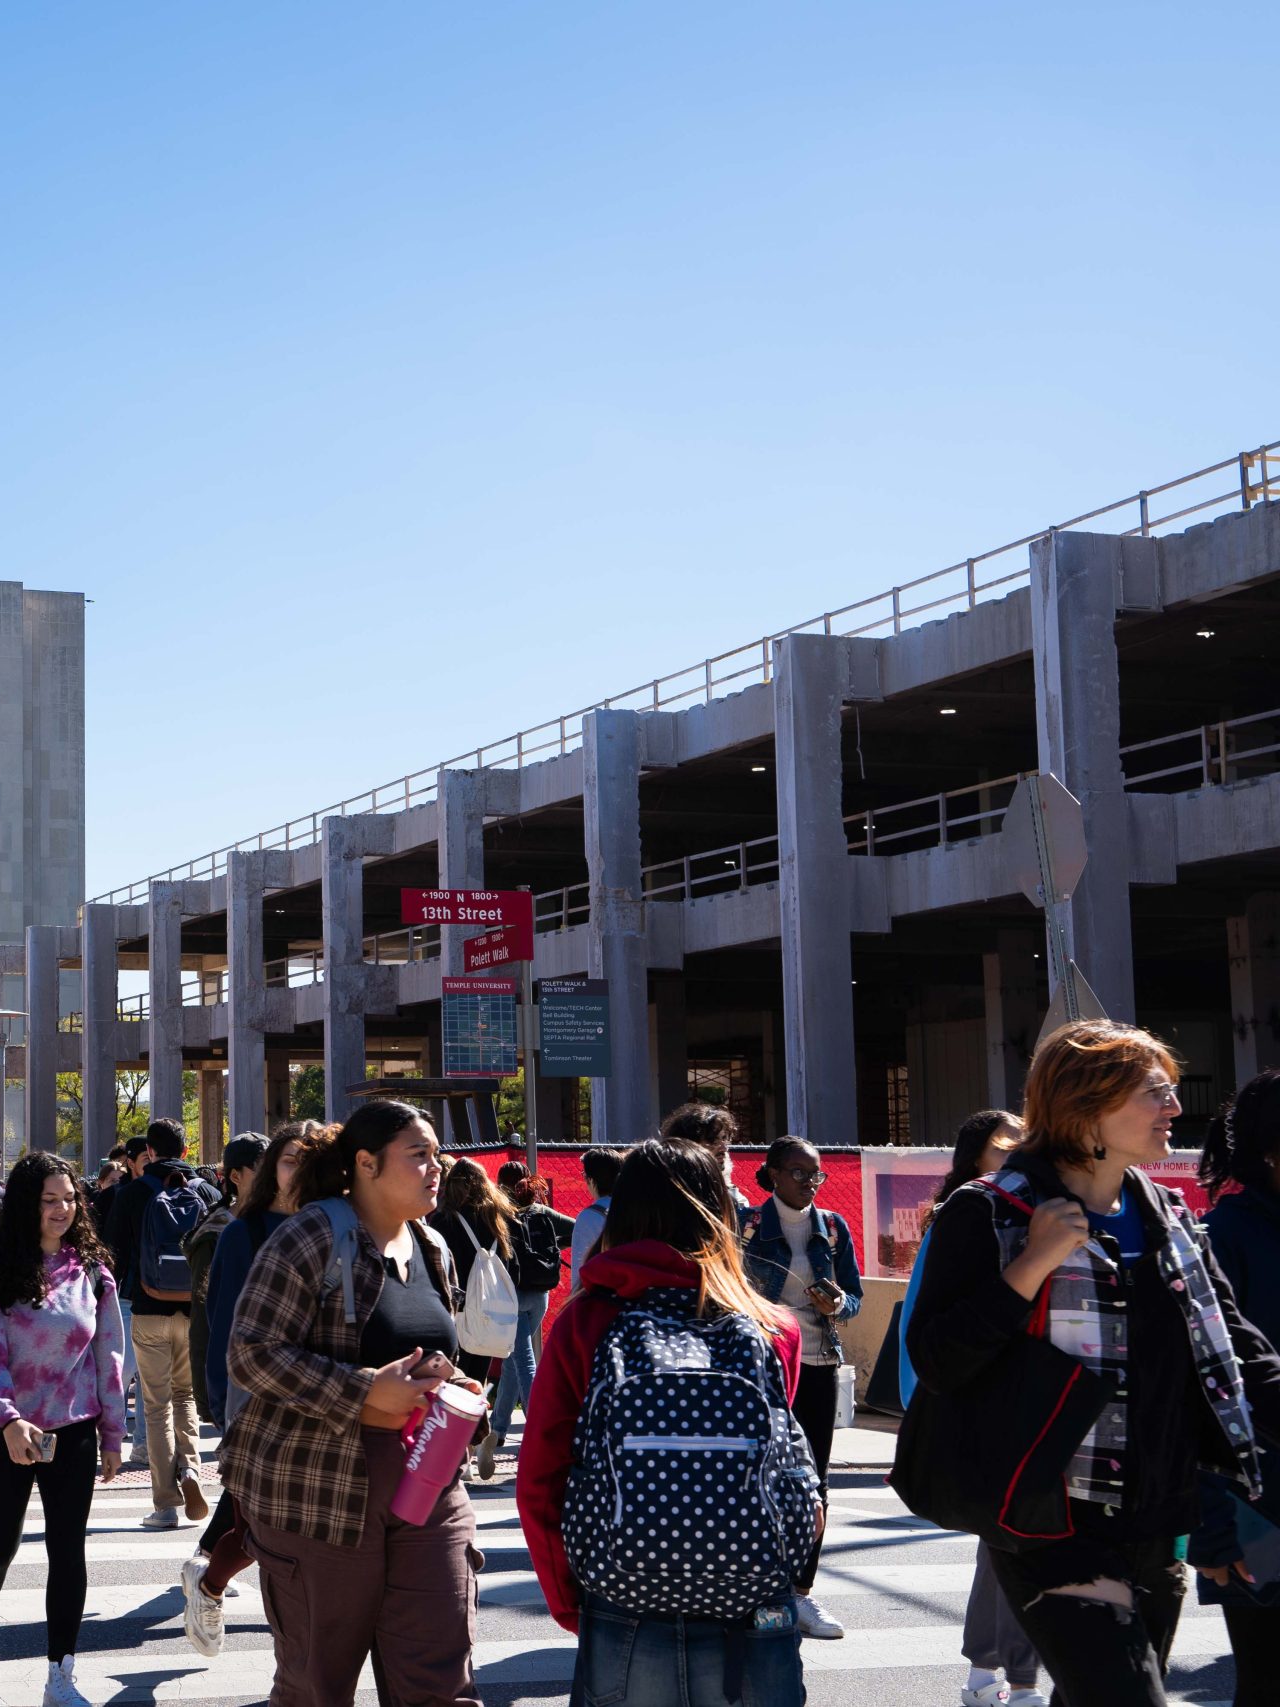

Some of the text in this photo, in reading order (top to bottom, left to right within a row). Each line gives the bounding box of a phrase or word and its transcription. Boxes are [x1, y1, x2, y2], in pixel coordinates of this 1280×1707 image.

[430, 892, 450, 900] 1900
[457, 893, 464, 902] N
[422, 906, 502, 920] 13th Street
[470, 946, 509, 967] Polett Walk
